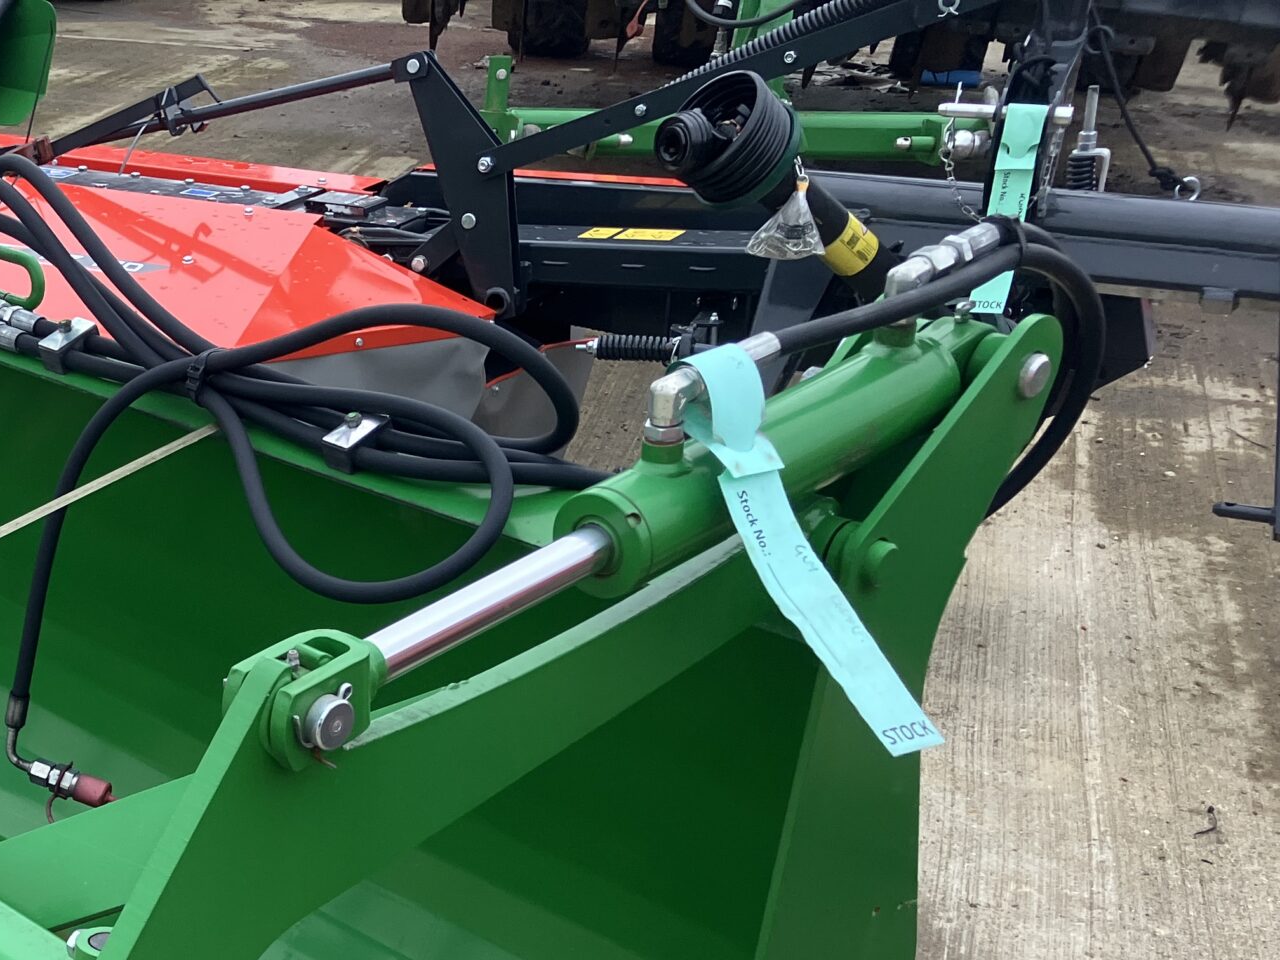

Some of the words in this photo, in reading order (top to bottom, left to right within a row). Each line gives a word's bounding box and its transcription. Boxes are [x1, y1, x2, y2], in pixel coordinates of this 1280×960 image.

[977, 300, 1002, 309] TOCK
[737, 490, 758, 527] Stock
[882, 720, 935, 745] STOCK
